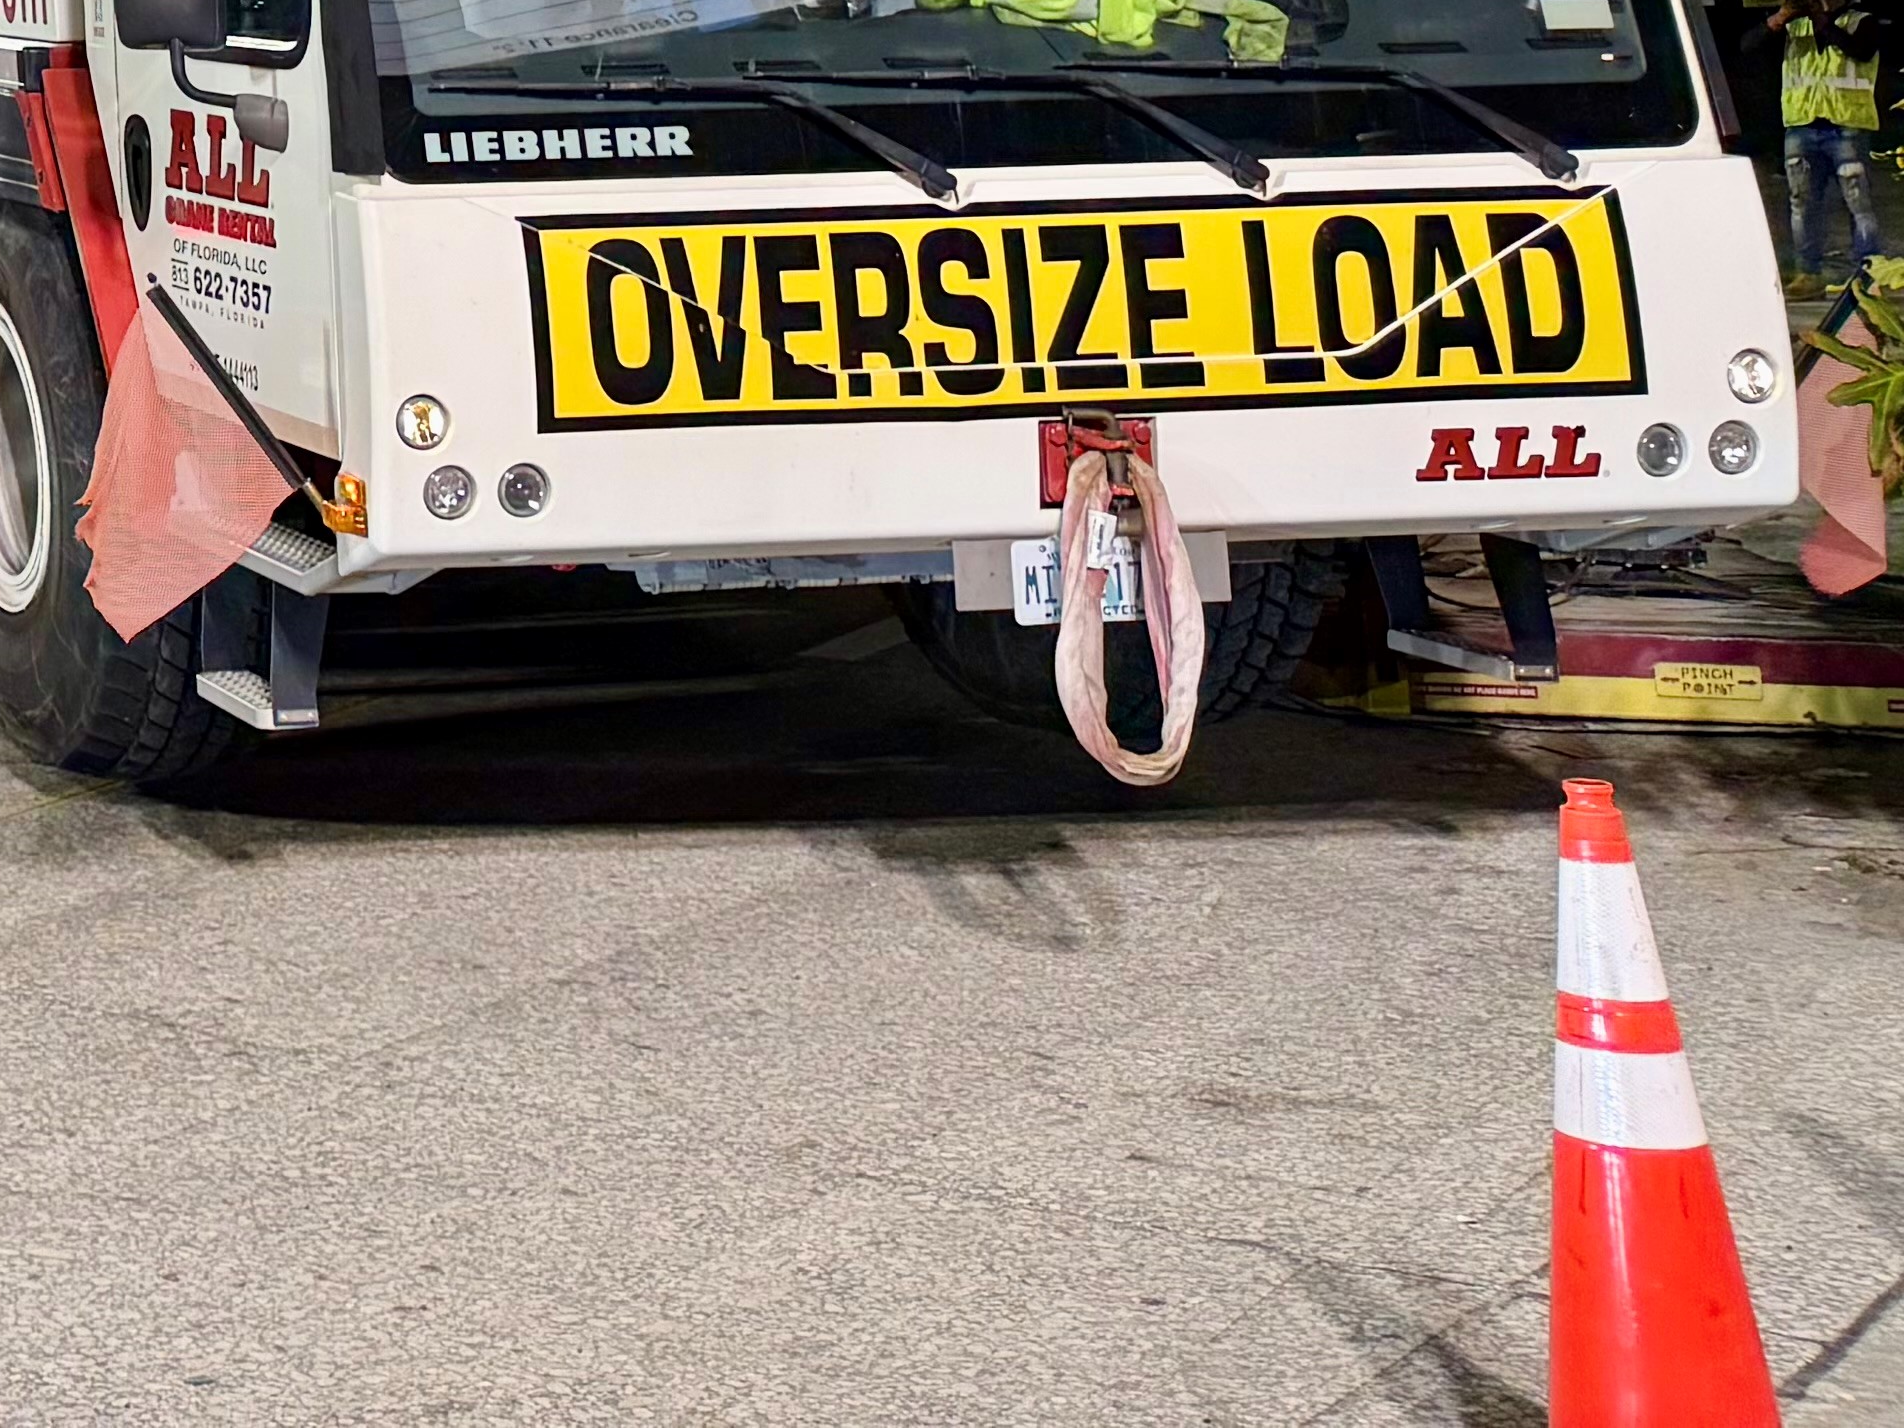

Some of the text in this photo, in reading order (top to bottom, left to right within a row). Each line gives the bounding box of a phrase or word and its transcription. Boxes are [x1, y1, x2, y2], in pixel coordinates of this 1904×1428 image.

[165, 108, 270, 209] ALL
[423, 125, 694, 163] LIEBHERR
[172, 265, 189, 285] 813
[173, 238, 189, 254] OF
[245, 255, 268, 275] LLC
[586, 213, 1586, 406] OVERSIZE LOAD
[1415, 425, 1602, 482] ALL
[1681, 666, 1733, 680] PINCH
[1683, 682, 1735, 695] POINT
